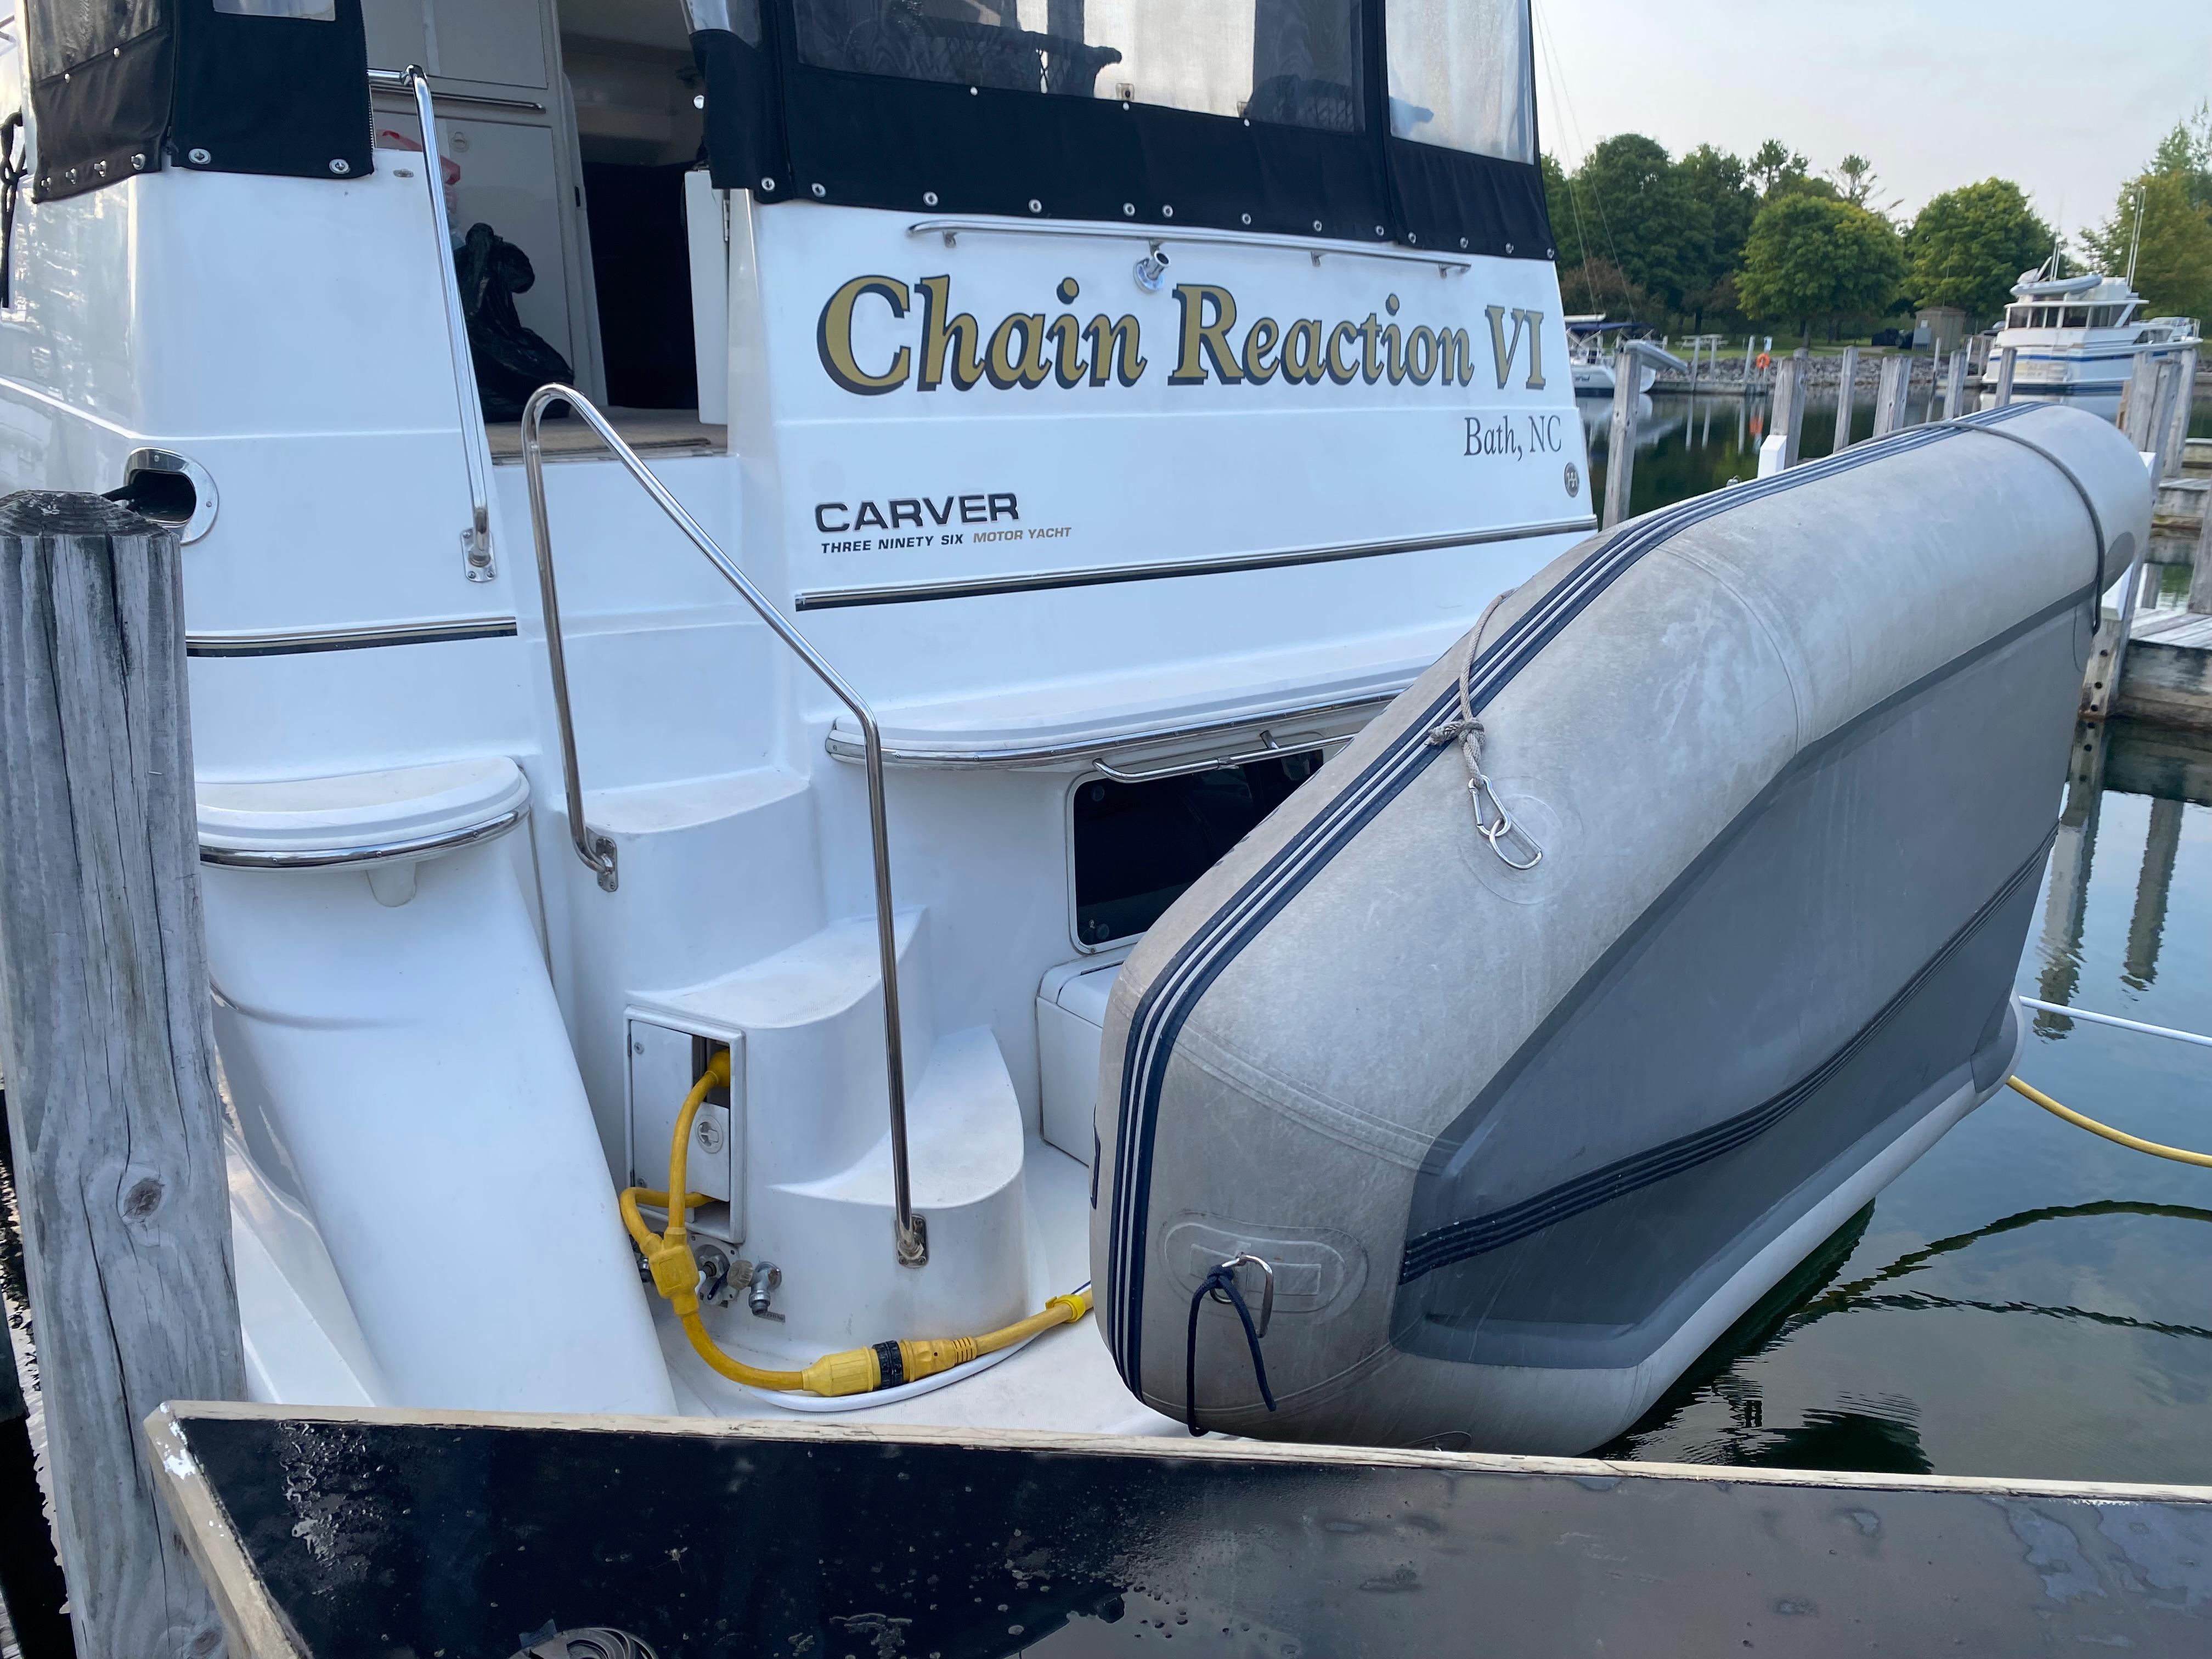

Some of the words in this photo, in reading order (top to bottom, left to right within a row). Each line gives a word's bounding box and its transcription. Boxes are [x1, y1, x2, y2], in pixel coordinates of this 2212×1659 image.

[816, 274, 1148, 396] Chain
[1167, 283, 1475, 387] Reaction
[1485, 304, 1547, 390] VI
[1463, 415, 1522, 461] Bath,
[1528, 415, 1561, 453] NC
[815, 492, 1019, 533] CARVER
[821, 539, 872, 554] THREE
[878, 535, 934, 550] NINETY
[941, 533, 963, 545] SIX
[973, 530, 1023, 543] MOTOR
[1028, 527, 1073, 539] YACHT
